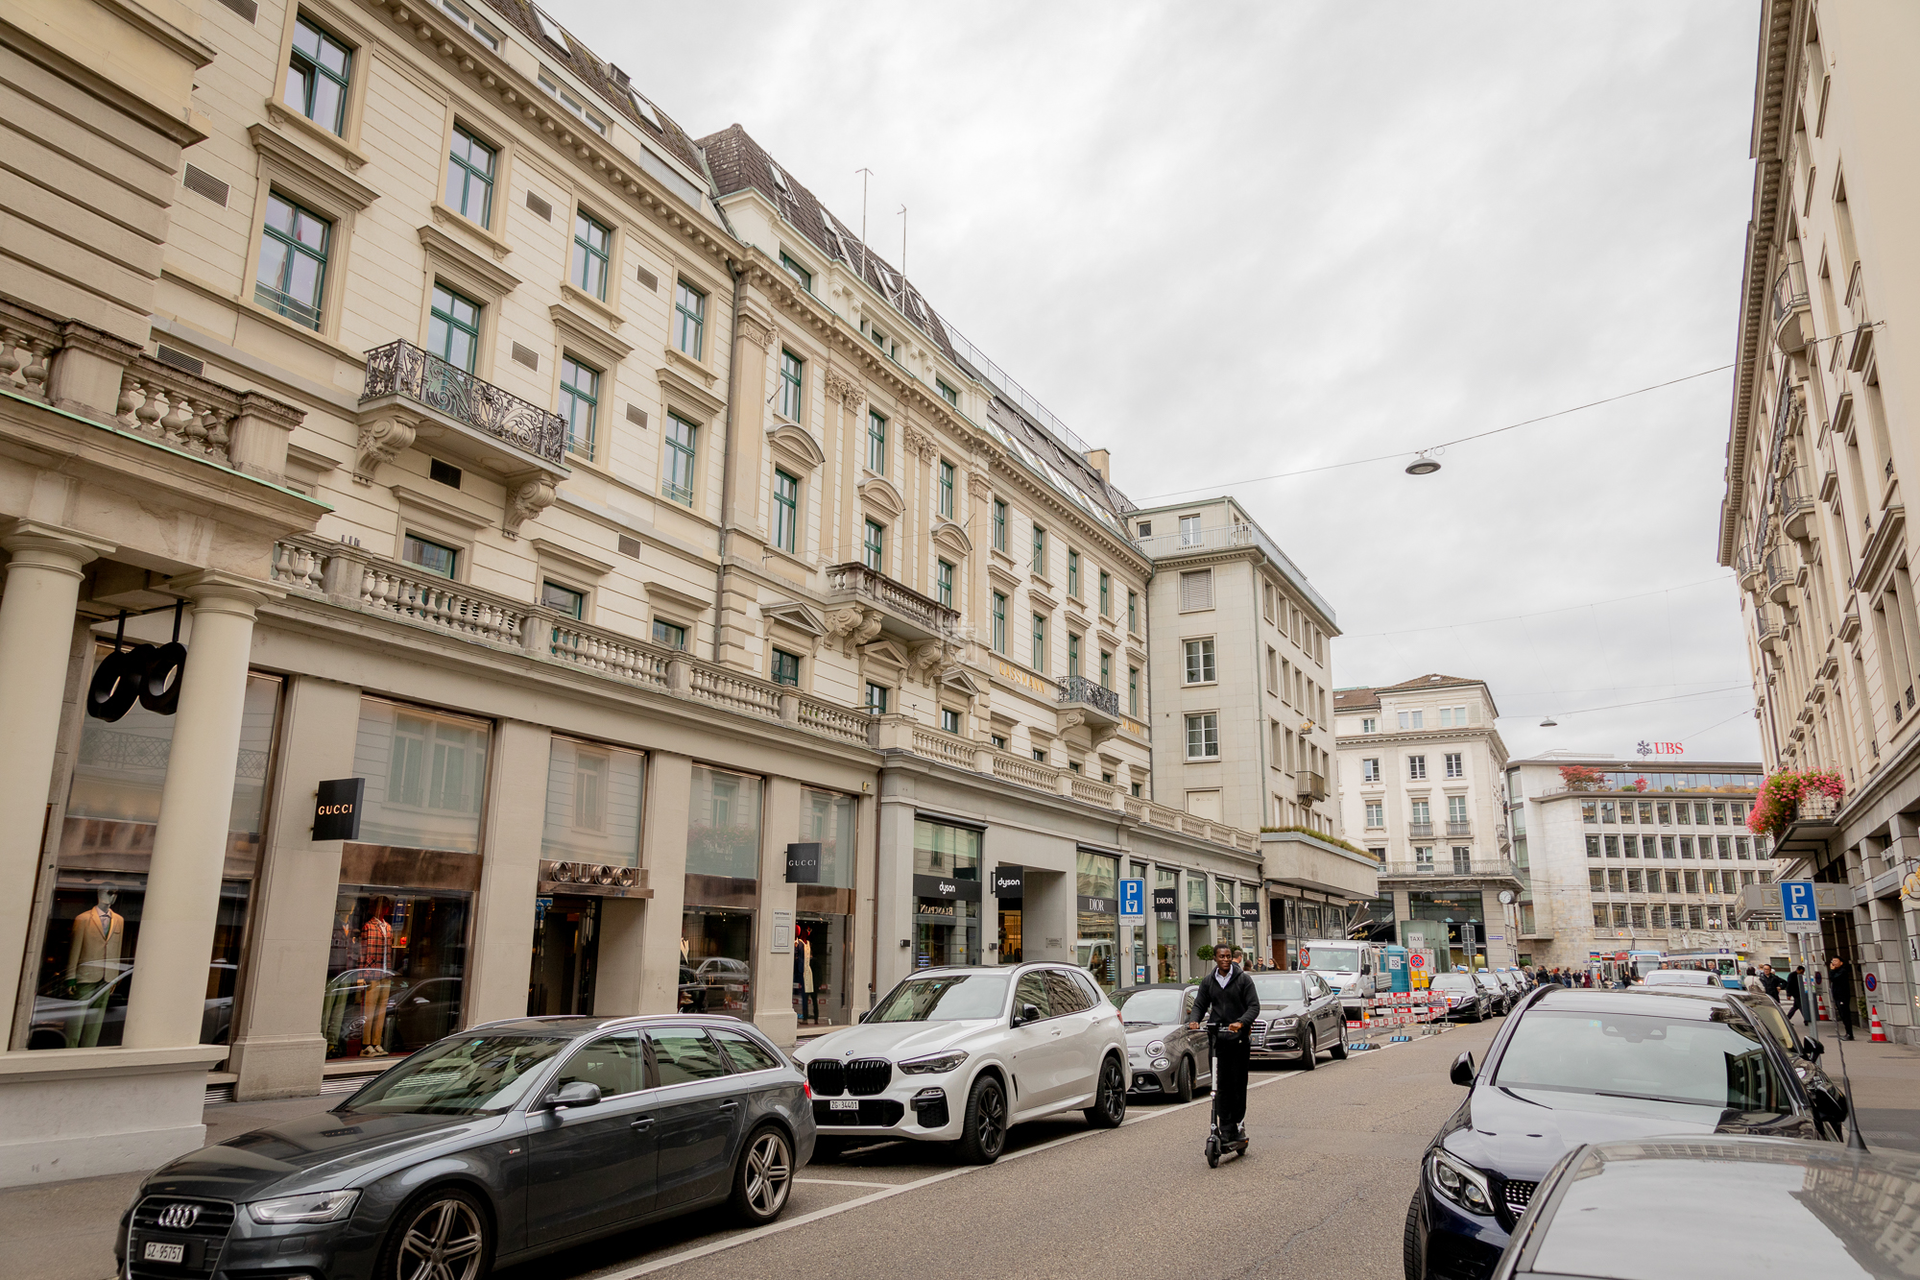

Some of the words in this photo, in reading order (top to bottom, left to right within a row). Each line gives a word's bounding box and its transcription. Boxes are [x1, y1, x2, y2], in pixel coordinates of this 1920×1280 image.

[999, 662, 1045, 694] GASSMANN
[1654, 741, 1684, 755] UBS
[318, 803, 353, 816] GUCCI
[788, 859, 816, 867] GUCCI
[549, 860, 642, 888] GUCCI
[939, 881, 956, 895] dyson
[998, 877, 1021, 888] dyson
[1127, 882, 1138, 900] P
[1790, 884, 1806, 904] P
[1089, 898, 1104, 912] DIOR
